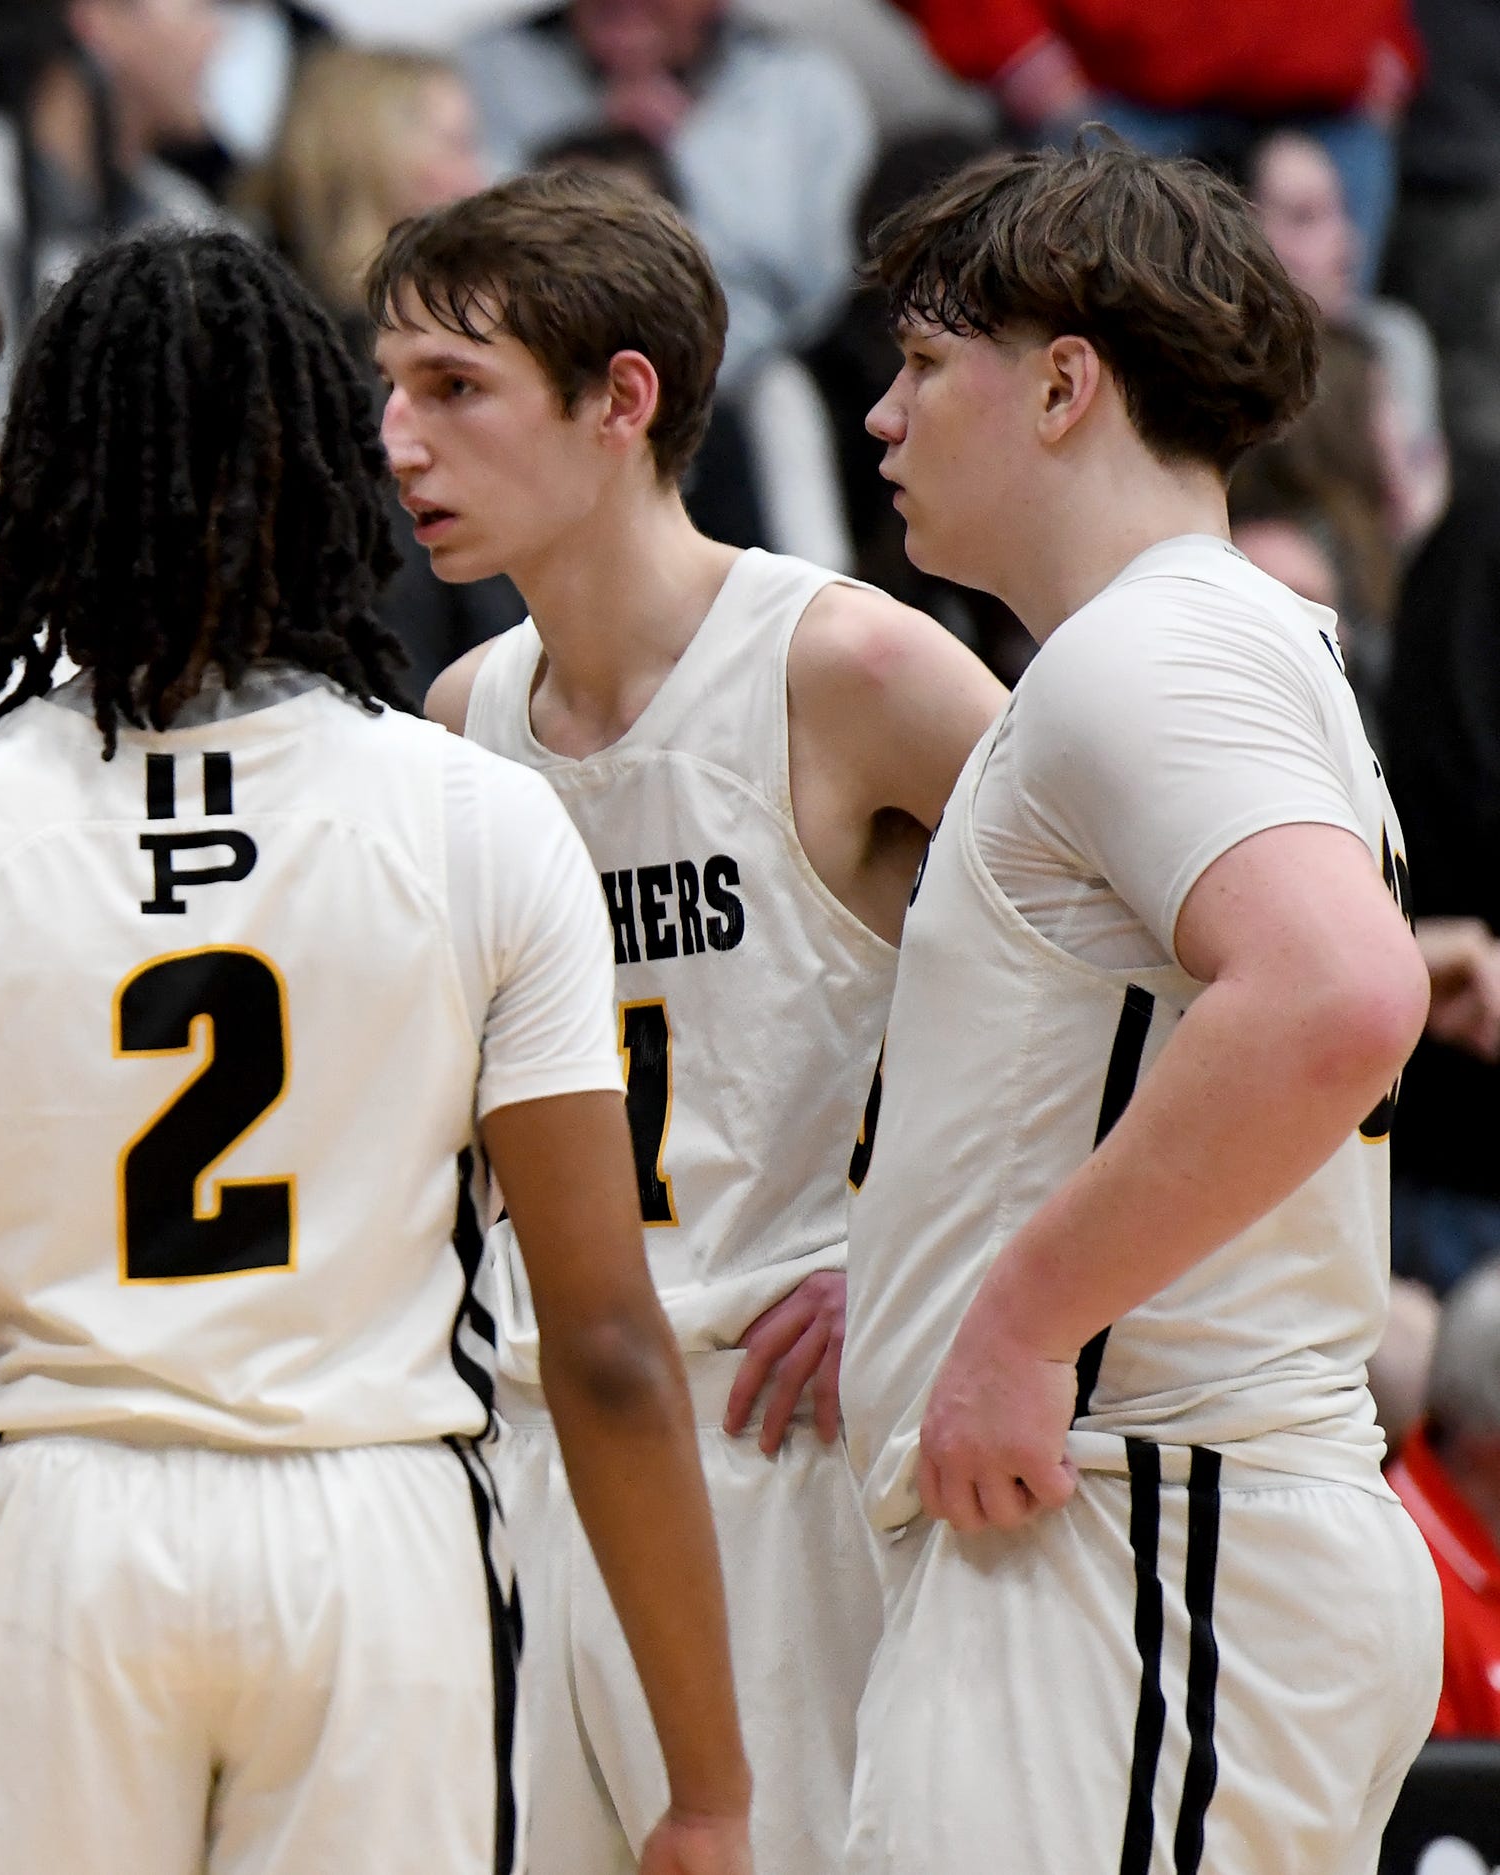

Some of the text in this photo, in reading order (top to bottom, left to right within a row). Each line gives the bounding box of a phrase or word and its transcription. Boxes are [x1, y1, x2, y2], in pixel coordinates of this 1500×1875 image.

[139, 830, 258, 914] P
[601, 854, 745, 965] HERS
[112, 944, 296, 1286] 2
